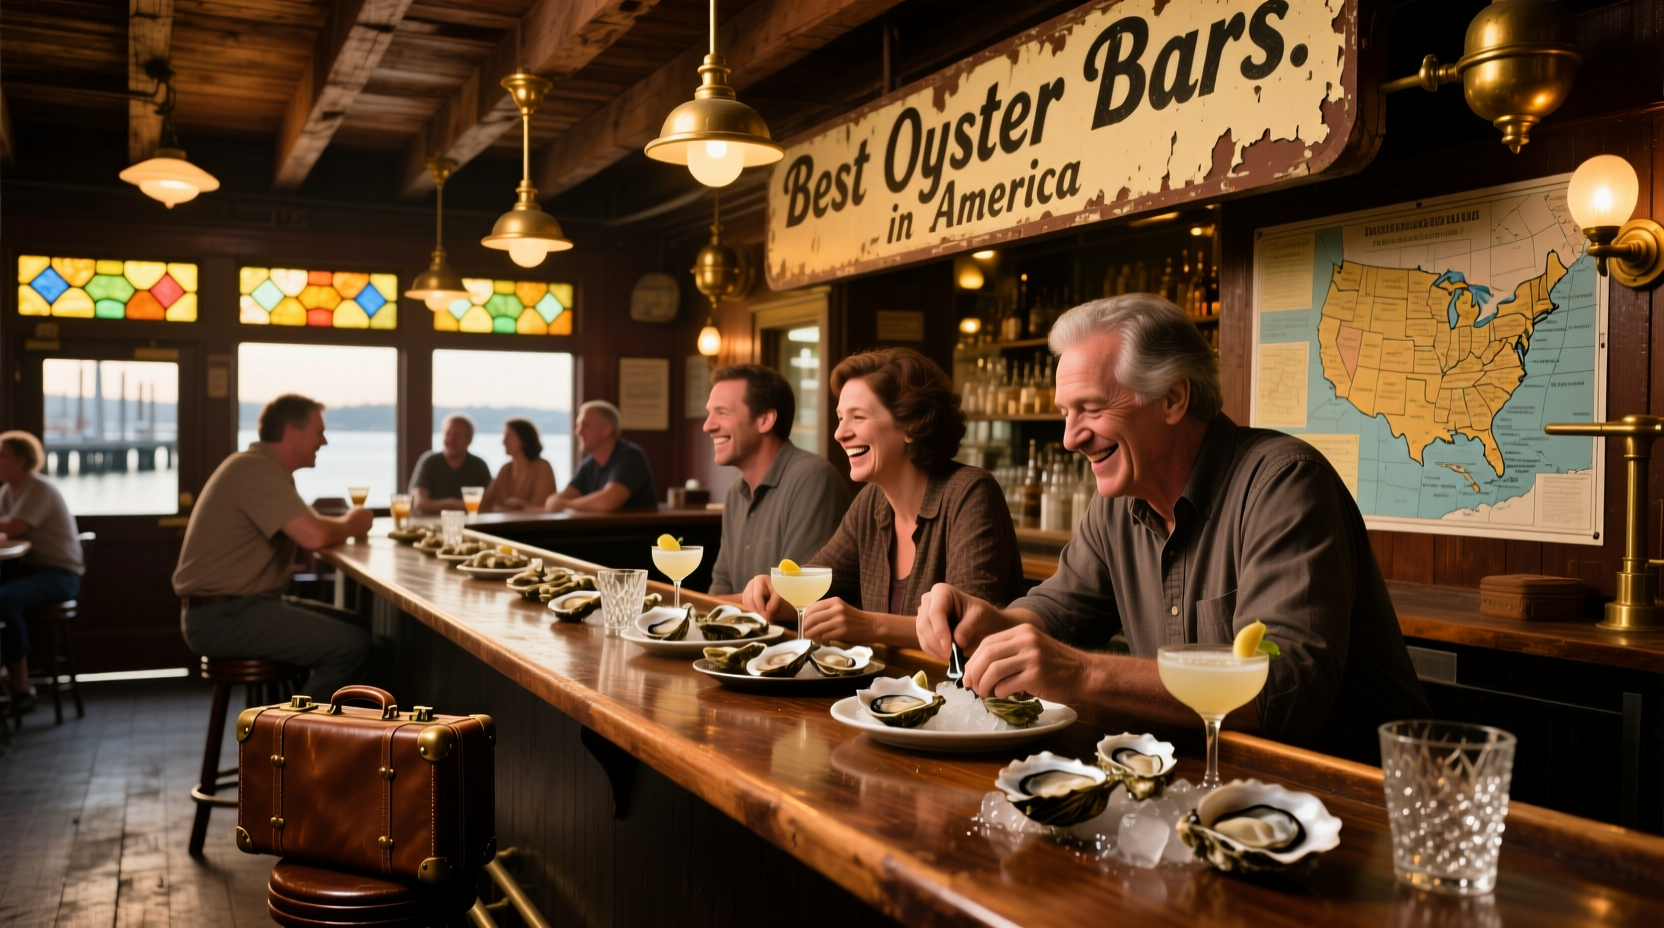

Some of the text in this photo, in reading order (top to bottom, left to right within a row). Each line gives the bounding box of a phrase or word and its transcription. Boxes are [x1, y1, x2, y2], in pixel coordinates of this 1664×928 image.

[783, 0, 1309, 228] Best Oyster Bars.
[887, 158, 1082, 244] in America
